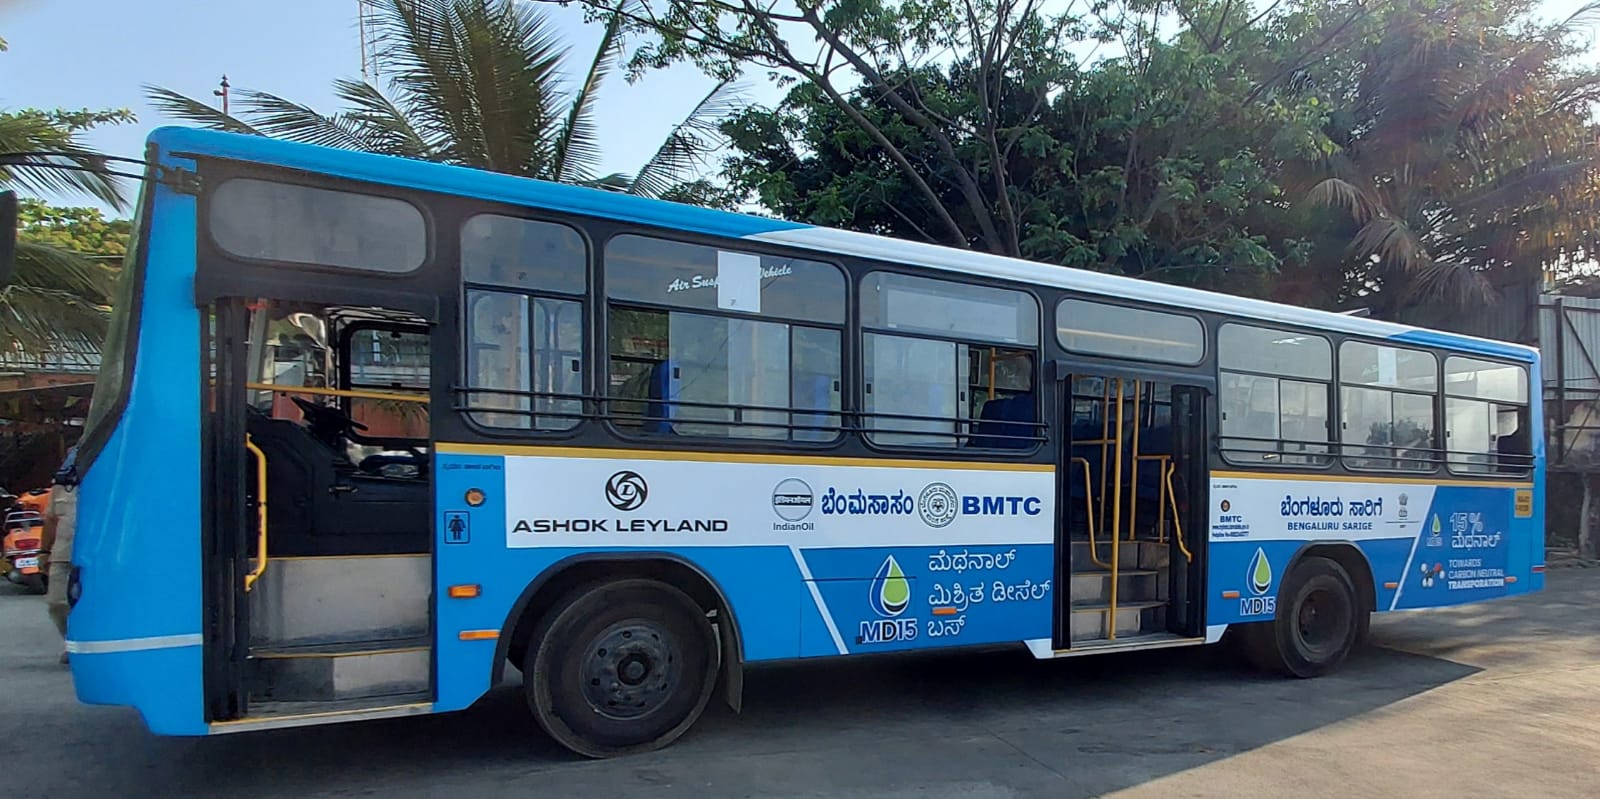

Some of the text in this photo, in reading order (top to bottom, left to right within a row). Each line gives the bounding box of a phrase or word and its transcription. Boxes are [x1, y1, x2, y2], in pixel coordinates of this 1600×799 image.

[667, 278, 690, 293] Air
[821, 487, 914, 514] ಬೆಂಮಸಾಸಂ
[962, 496, 1041, 516] BMTC
[1280, 495, 1383, 517] ಬೆಂಗಳೂರು ಸಾರಿಗೆ
[512, 519, 729, 533] ASHOK LEYLAND
[773, 522, 814, 531] IndianOil
[1219, 515, 1242, 523] BMTC
[1287, 522, 1373, 531] BENGALURU SARIGE
[1451, 530, 1502, 551] ಮೆಥನಾಲ್
[928, 549, 1017, 574] ಮೆಥನಾಲ್
[1448, 558, 1482, 568] TOWARDS
[928, 579, 1052, 612] ಮಿಶ್ರಿತ ಡೀಸೆಲ್
[1240, 597, 1277, 616] MD15
[859, 618, 918, 644] MD15
[927, 615, 967, 637] ಬಸ್
